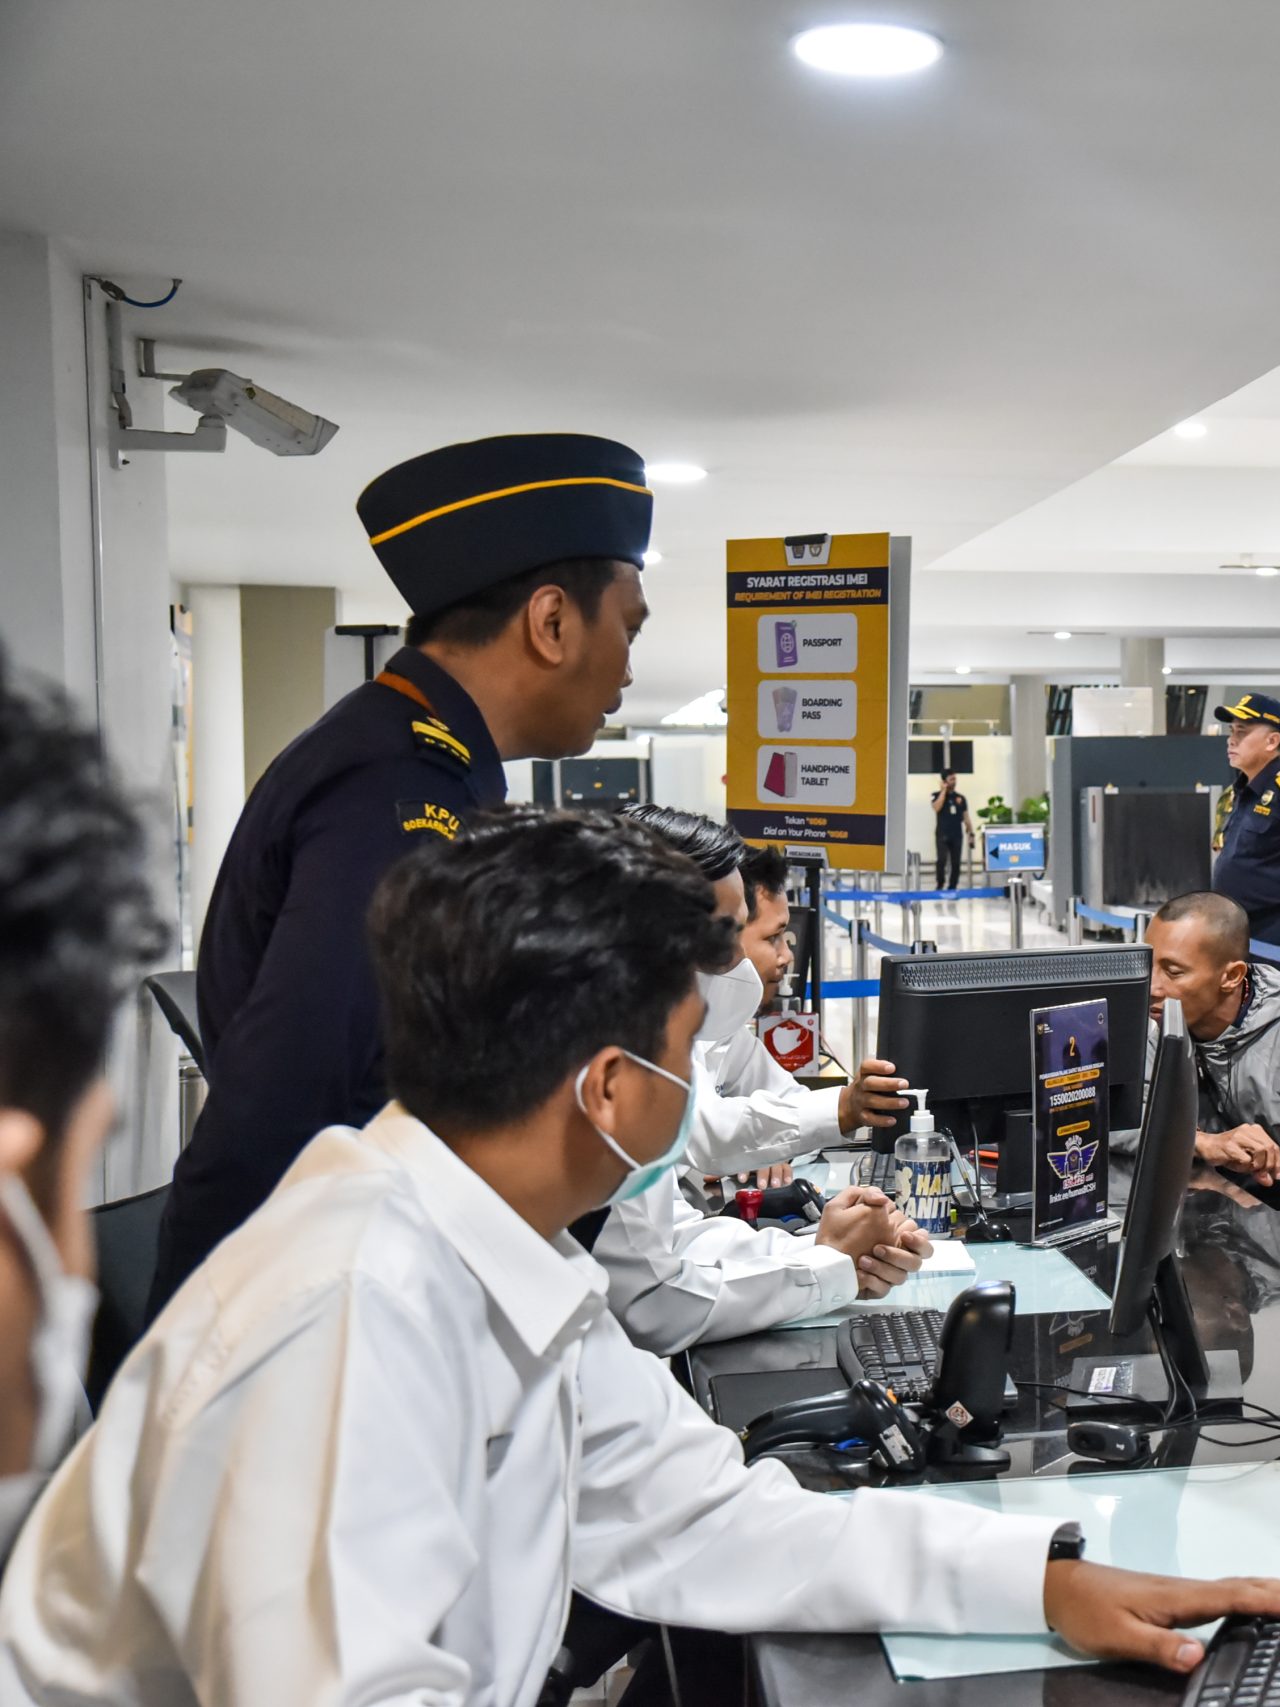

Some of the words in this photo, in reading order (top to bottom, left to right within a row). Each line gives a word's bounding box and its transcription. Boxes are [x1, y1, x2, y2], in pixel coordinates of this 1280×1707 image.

[747, 576, 786, 588] SYARAT
[787, 574, 844, 587] REGISTRASI
[846, 573, 868, 585] IMEI
[735, 591, 792, 602] REQUIREMENT
[793, 591, 804, 600] OF
[805, 590, 822, 600] IMEI
[823, 588, 881, 599] REGISTRATION
[802, 638, 842, 647] PASSPORT
[802, 698, 842, 707] BOARDING
[802, 711, 821, 720] PASS
[801, 764, 850, 774] HANDPHONE
[801, 777, 829, 786] TABLET
[424, 803, 460, 831] KPU
[784, 816, 806, 825] Tekan
[763, 827, 777, 836] Dial
[788, 828, 803, 837] Your
[804, 829, 826, 838] Phone
[999, 842, 1032, 851] MASUK
[1069, 1036, 1076, 1057] 2
